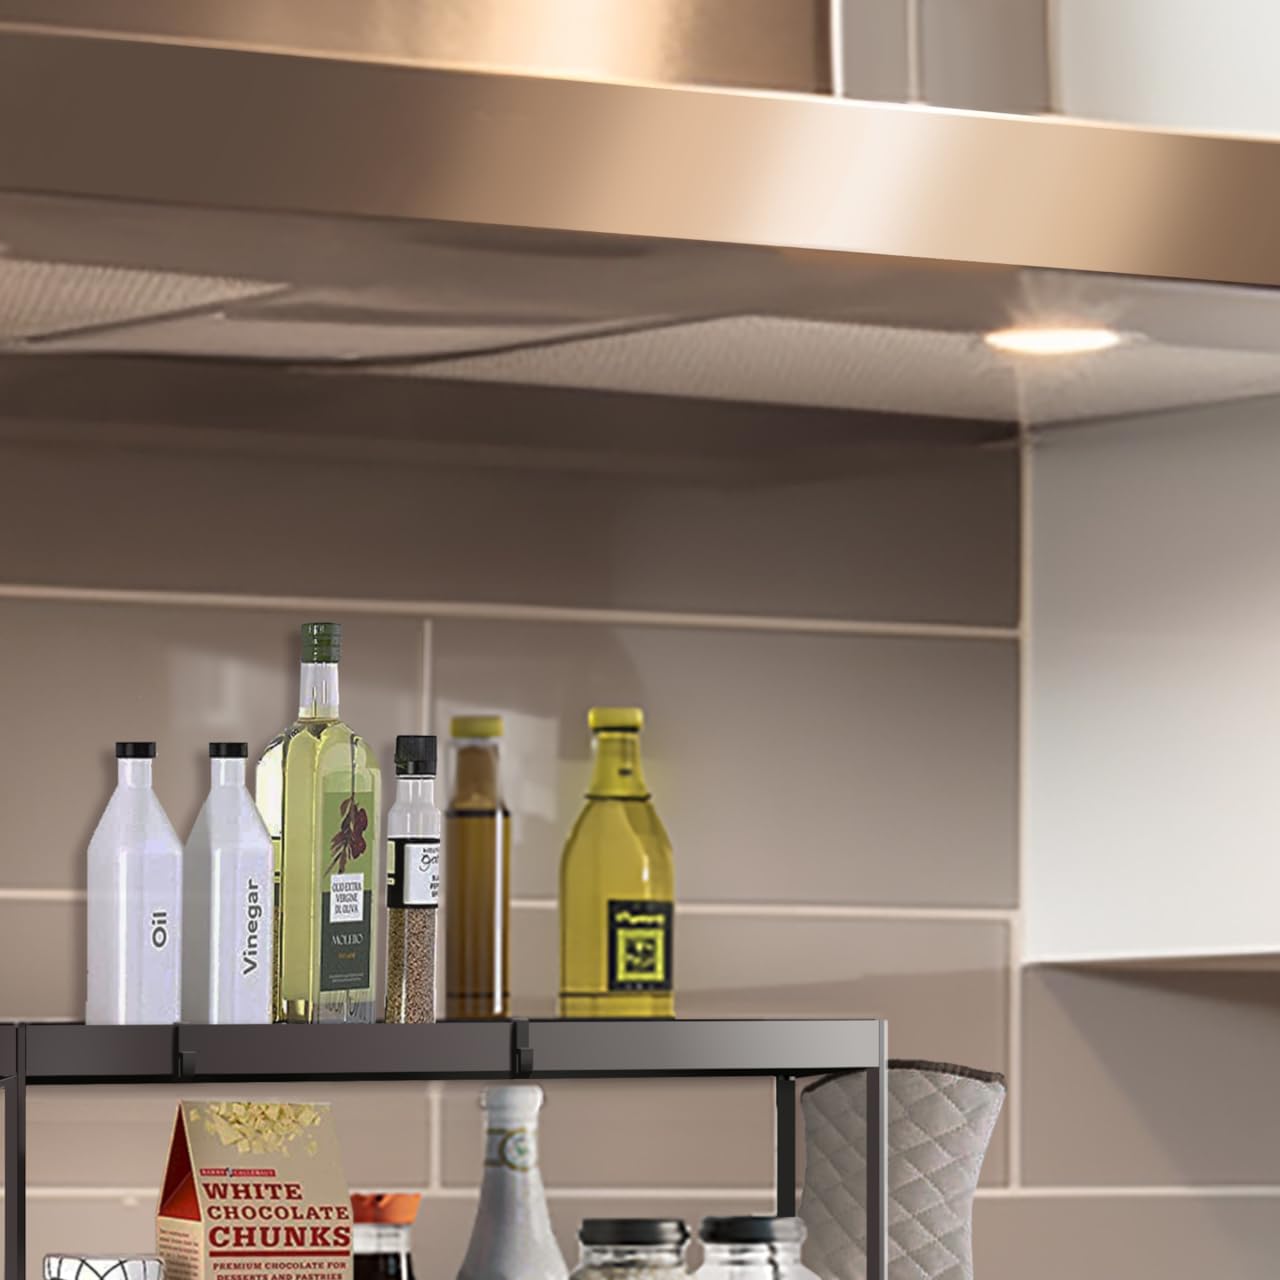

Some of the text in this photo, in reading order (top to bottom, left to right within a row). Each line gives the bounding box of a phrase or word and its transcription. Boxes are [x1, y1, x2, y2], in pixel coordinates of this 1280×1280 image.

[152, 912, 167, 948] Oil
[242, 879, 262, 975] Vinegar
[202, 1183, 303, 1200] WHITE
[207, 1205, 350, 1220] CHOCOLATE
[208, 1226, 351, 1248] CHUNKS
[264, 1262, 324, 1270] CHOCOLATE
[296, 1273, 343, 1280] PASTRIES
